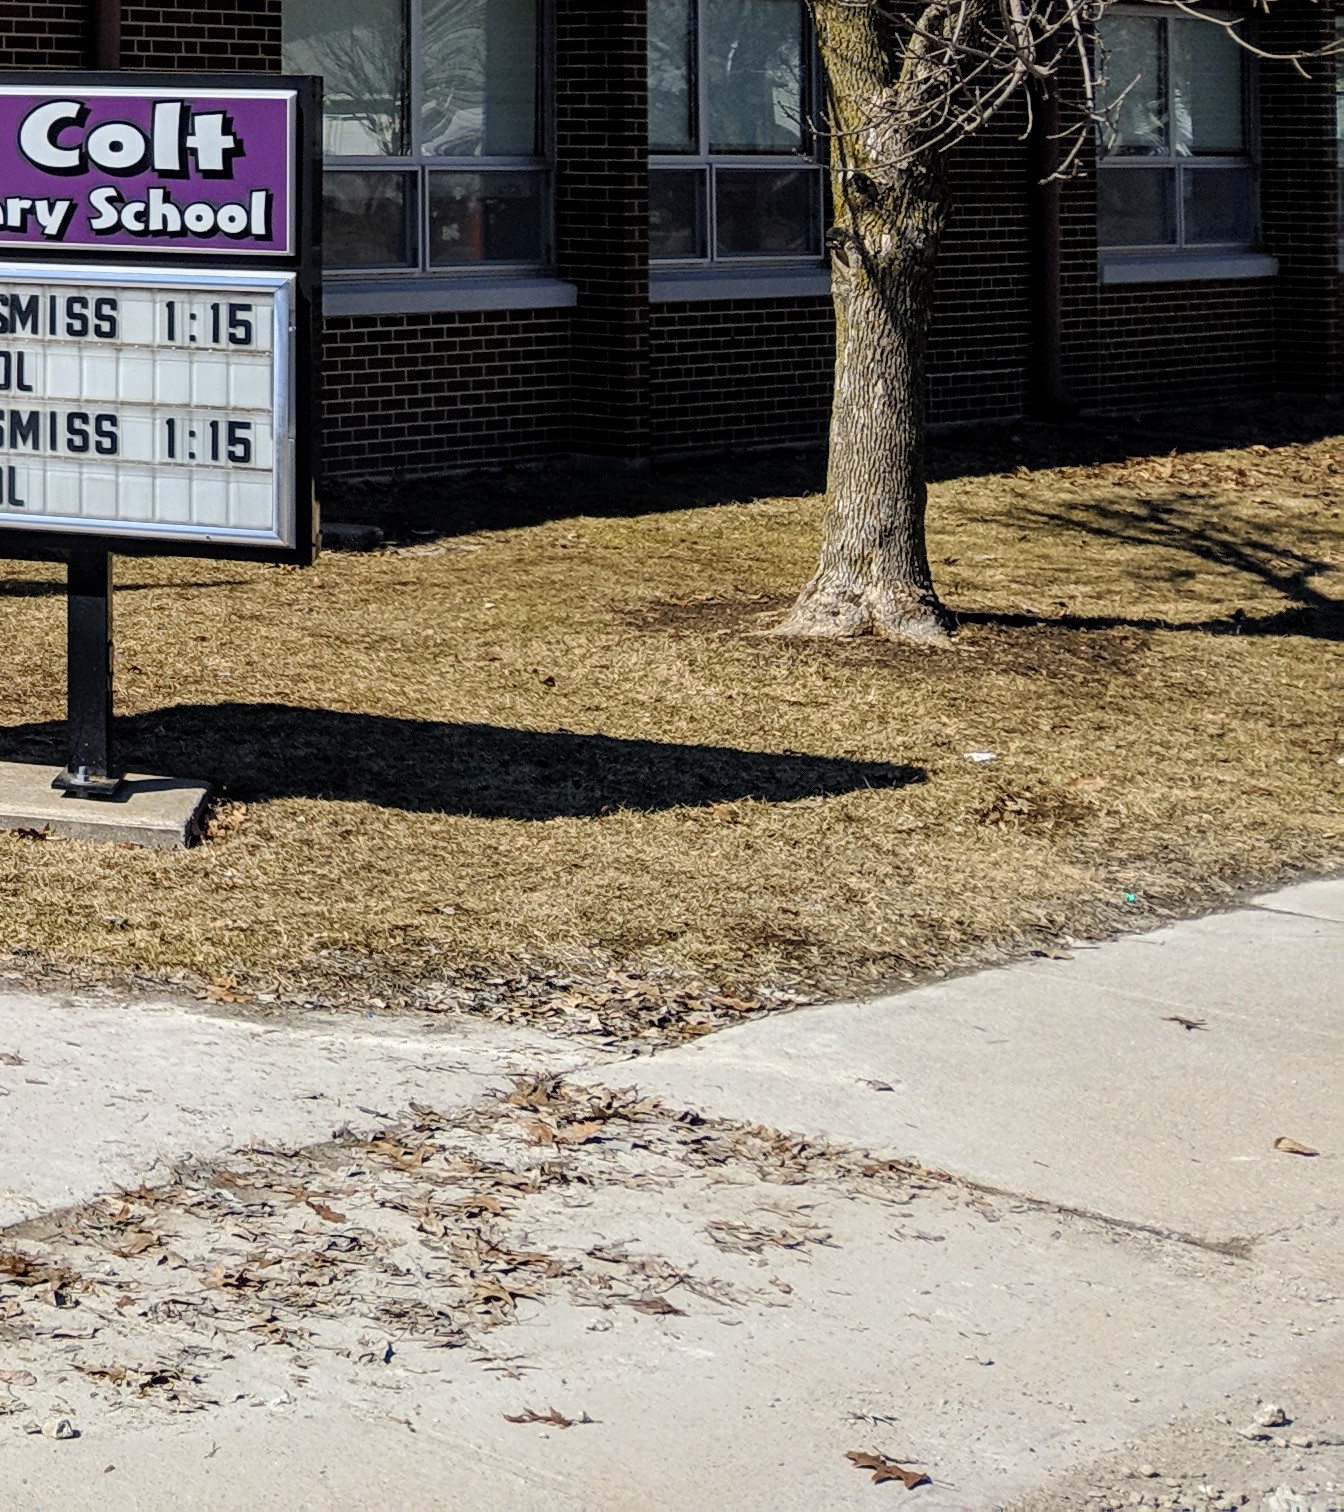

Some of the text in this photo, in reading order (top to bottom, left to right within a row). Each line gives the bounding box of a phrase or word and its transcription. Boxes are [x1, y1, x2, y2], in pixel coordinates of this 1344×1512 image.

[19, 99, 236, 174] Colt
[89, 187, 269, 237] School
[166, 300, 253, 345] 1:15
[165, 417, 252, 464] 1:15
